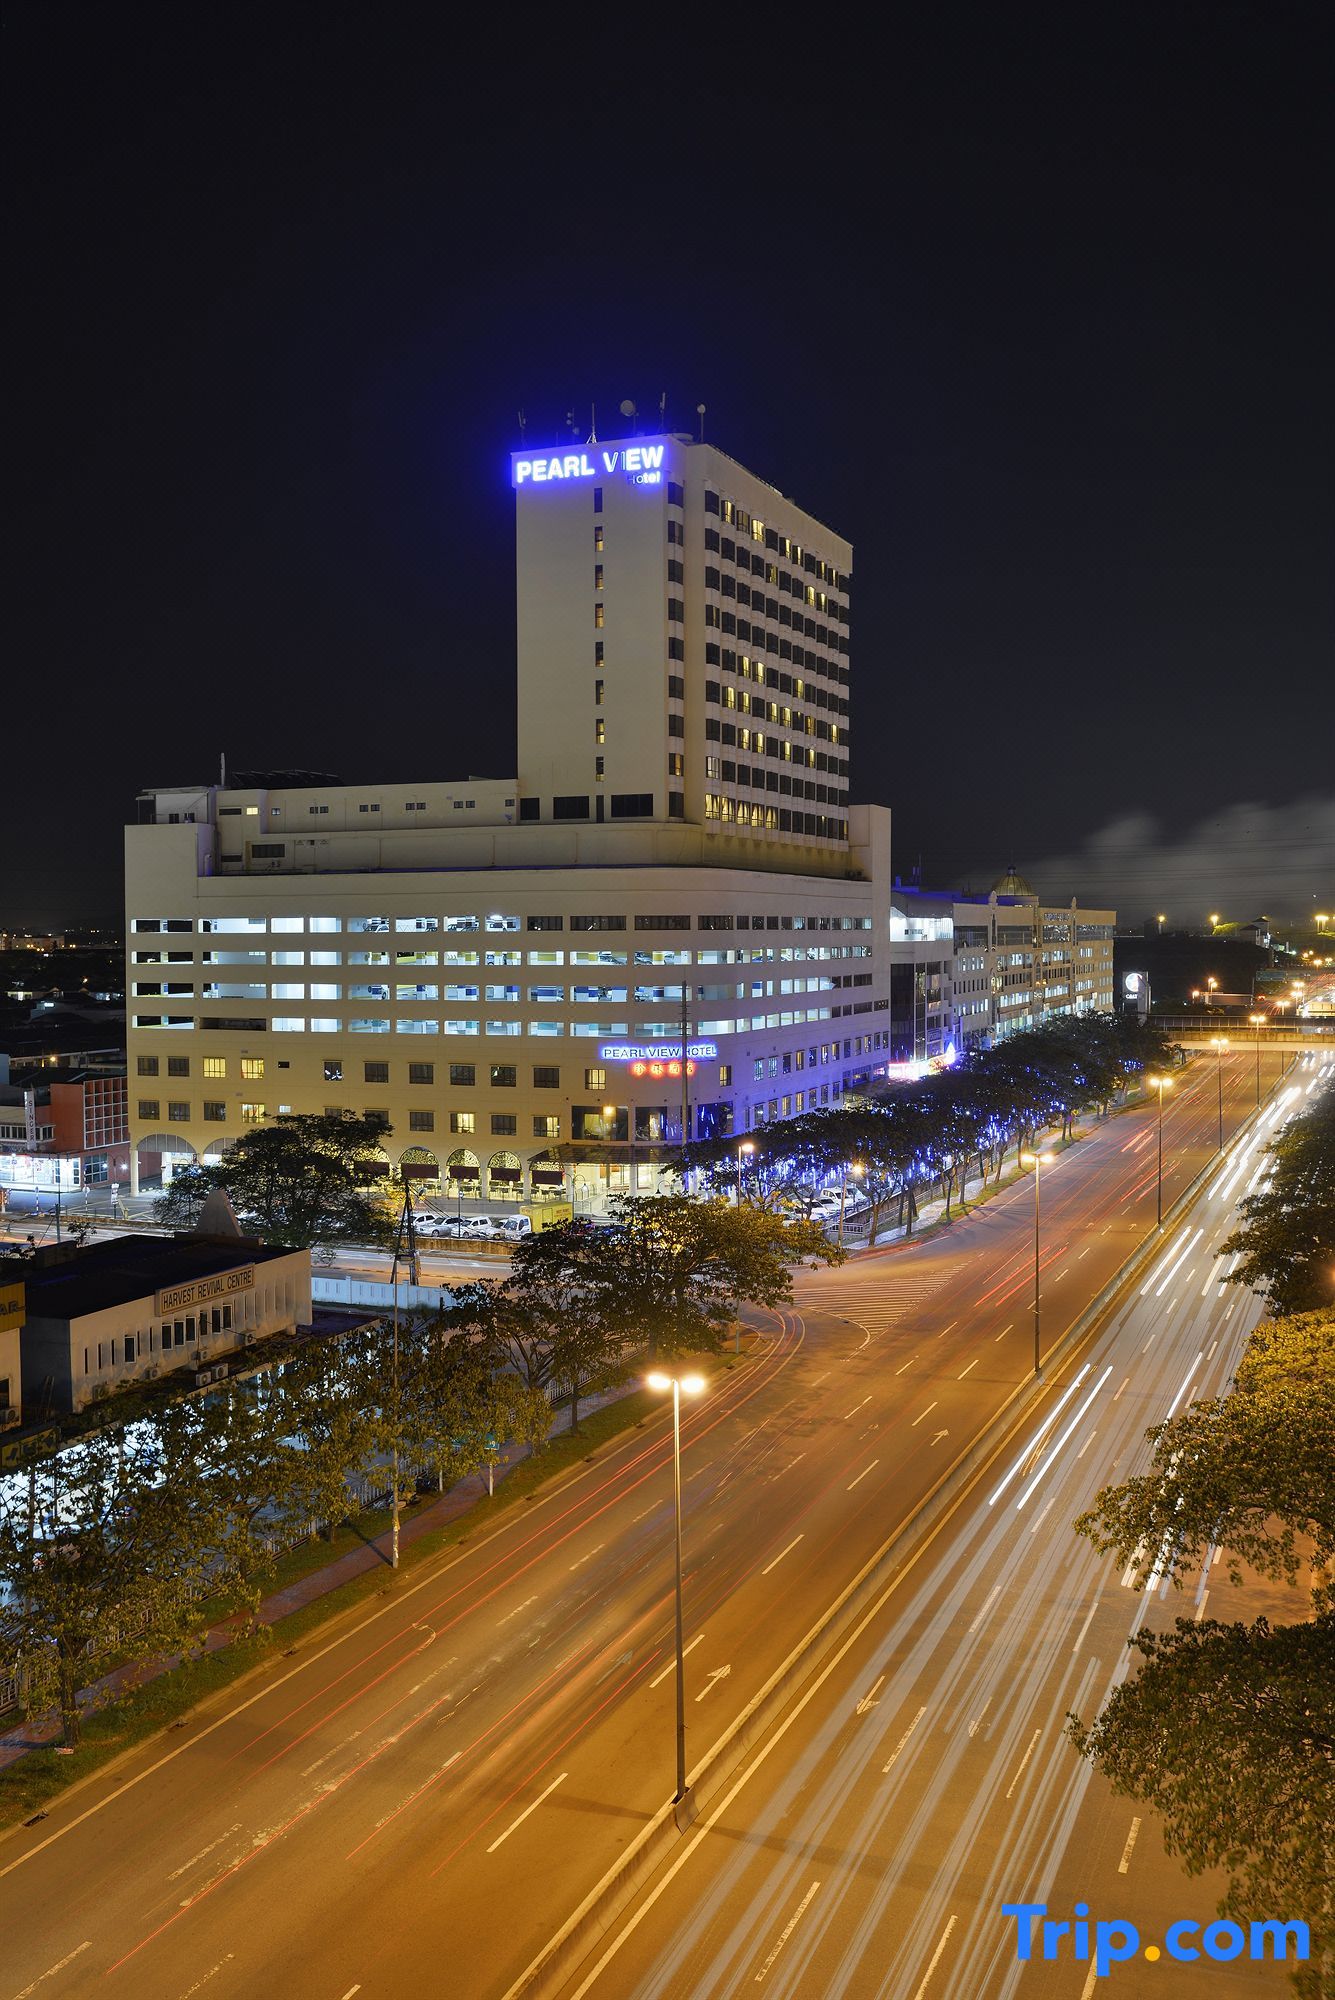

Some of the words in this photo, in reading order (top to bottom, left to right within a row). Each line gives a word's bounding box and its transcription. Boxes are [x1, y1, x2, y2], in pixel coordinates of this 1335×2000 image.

[516, 454, 596, 484] PEARL
[602, 445, 665, 473] VIEW
[603, 1047, 646, 1058] PEARL
[648, 1047, 681, 1058] VIEW
[163, 1287, 195, 1310] HARVEST
[198, 1279, 224, 1299] REVIVAL
[227, 1270, 252, 1289] CENTRE
